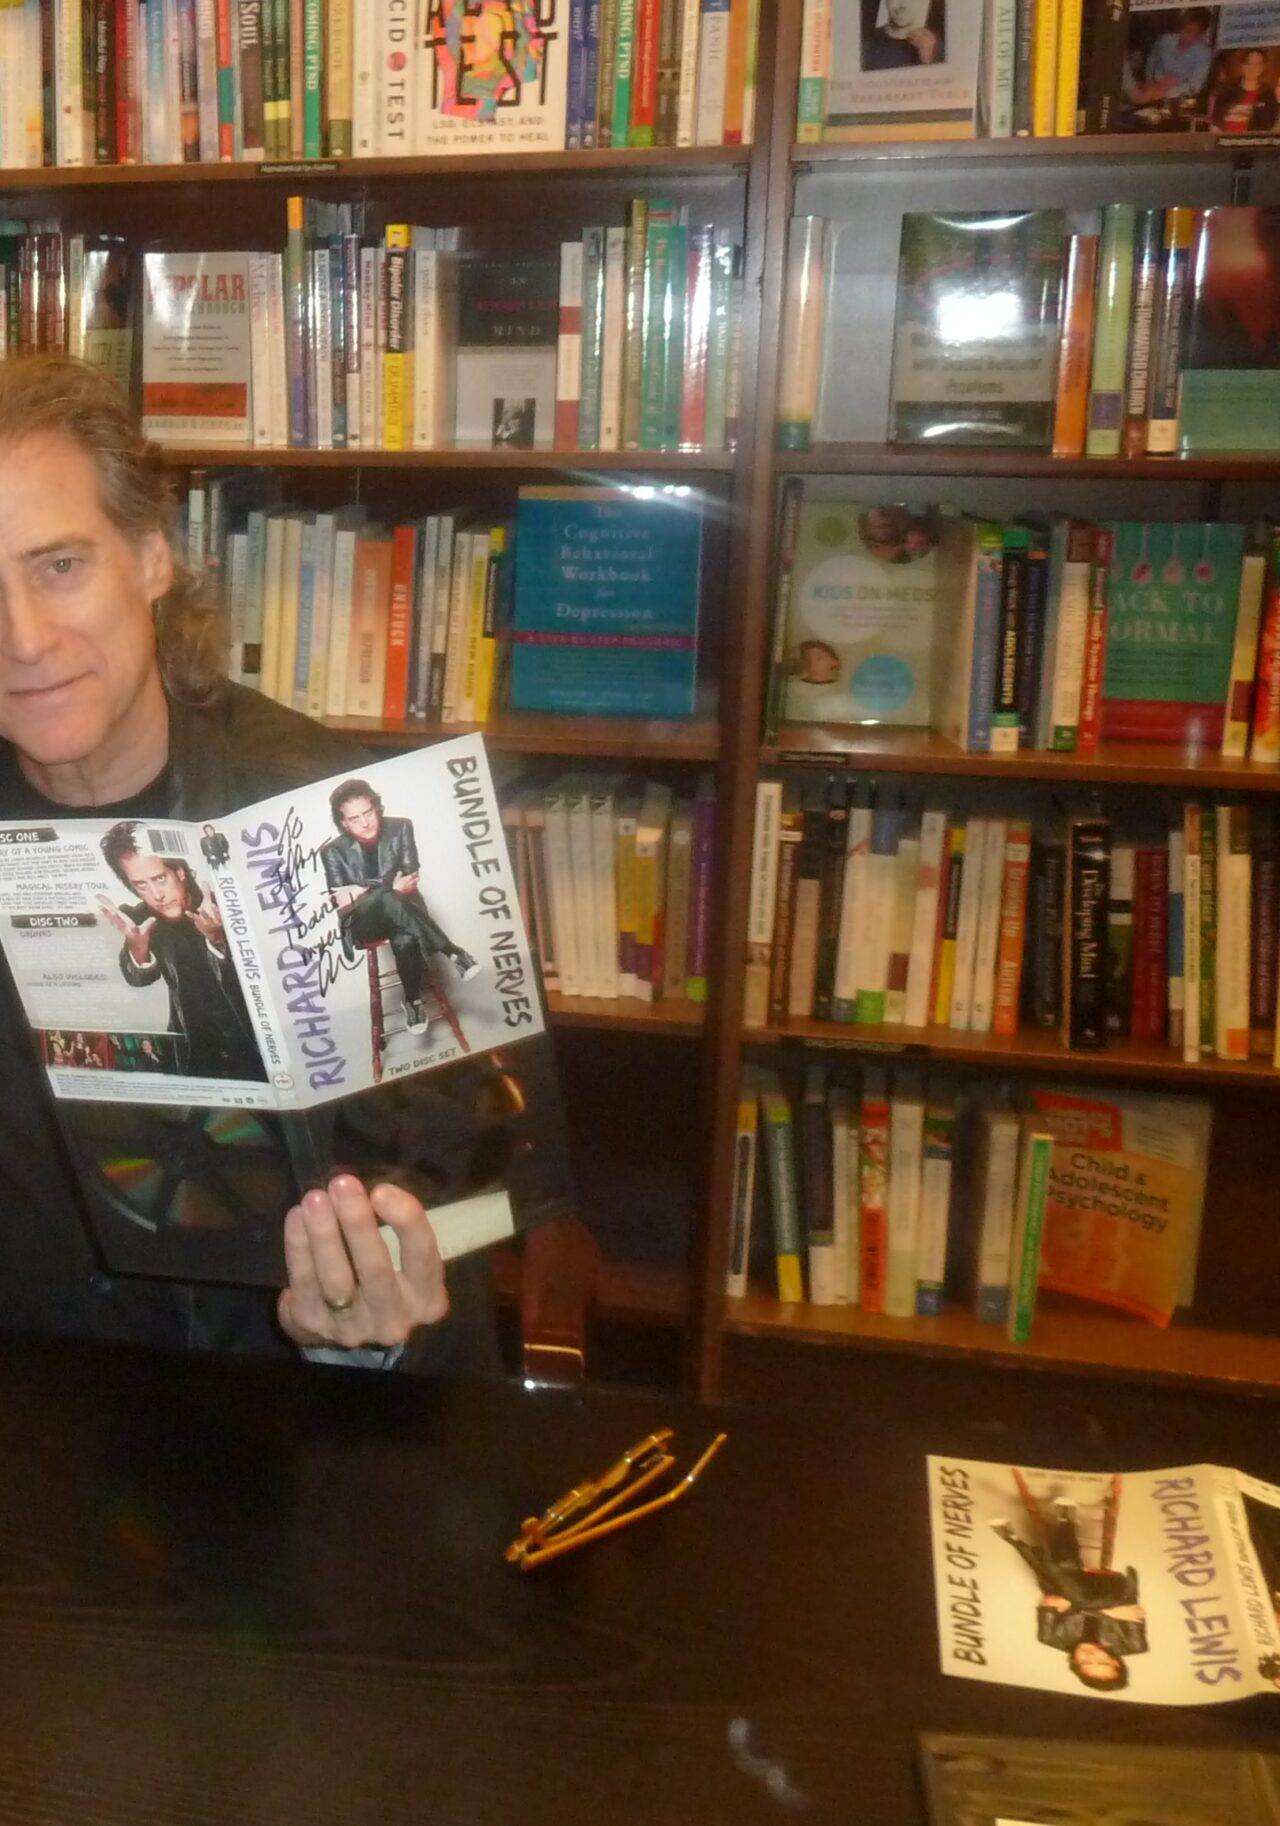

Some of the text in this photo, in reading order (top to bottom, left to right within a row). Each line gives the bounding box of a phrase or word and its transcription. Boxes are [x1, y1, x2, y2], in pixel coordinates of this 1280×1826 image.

[97, 20, 108, 53] Mindful
[240, 2, 260, 49] SOUL
[708, 15, 721, 65] PANIC
[618, 42, 631, 79] PTSD
[998, 39, 1011, 58] OF
[306, 54, 319, 90] PTSD
[997, 65, 1011, 89] ME
[387, 78, 406, 139] TEST
[519, 117, 544, 126] AND
[426, 132, 550, 145] THE POWER TO HEAL
[148, 274, 245, 303] POLAR
[317, 252, 328, 292] ALMOST
[388, 257, 403, 298] Bipolar
[363, 260, 373, 329] Monkey Mind
[390, 300, 402, 350] Disorder
[492, 325, 541, 336] MIND
[1129, 370, 1148, 415] CHILDREN
[563, 525, 651, 542] Cognitive
[560, 544, 654, 560] Behavioral
[561, 565, 653, 582] Workbook
[593, 586, 616, 600] for
[813, 585, 852, 600] KIDS
[857, 585, 881, 601] ON
[1116, 590, 1223, 615] ACK TO
[391, 584, 407, 646] UNSTUCK
[555, 603, 655, 622] Depression
[1110, 620, 1220, 646] ORMAL
[1001, 630, 1016, 704] ADOLESCENTS
[1086, 642, 1101, 683] Systems
[1083, 684, 1097, 722] Therapy
[11, 847, 22, 857] OF
[32, 845, 62, 855] YOUNG
[63, 843, 89, 853] COMIC
[16, 832, 40, 842] ONE
[15, 881, 109, 891] MAGICAL MISERY TOUR
[241, 822, 307, 936] LEWIS
[445, 755, 534, 1029] BUNDLE OF NERVES
[29, 916, 79, 927] DISC TWO
[1074, 869, 1101, 939] Developing
[999, 867, 1025, 1008] Growing Up Autism
[218, 875, 281, 1066] RICHARD LEWIS BUNDLE OF NERVES
[1077, 941, 1102, 980] Mind
[276, 946, 347, 1090] RICHARD
[387, 1047, 458, 1077] TWO DISC SET
[1071, 1153, 1129, 1181] Child
[938, 1465, 989, 1667] BUNDLE OF NERVES
[1149, 1477, 1244, 1687] RICHARD LEWIS
[1235, 1562, 1261, 1598] LEWIS
[1245, 1598, 1275, 1648] RICHARD
